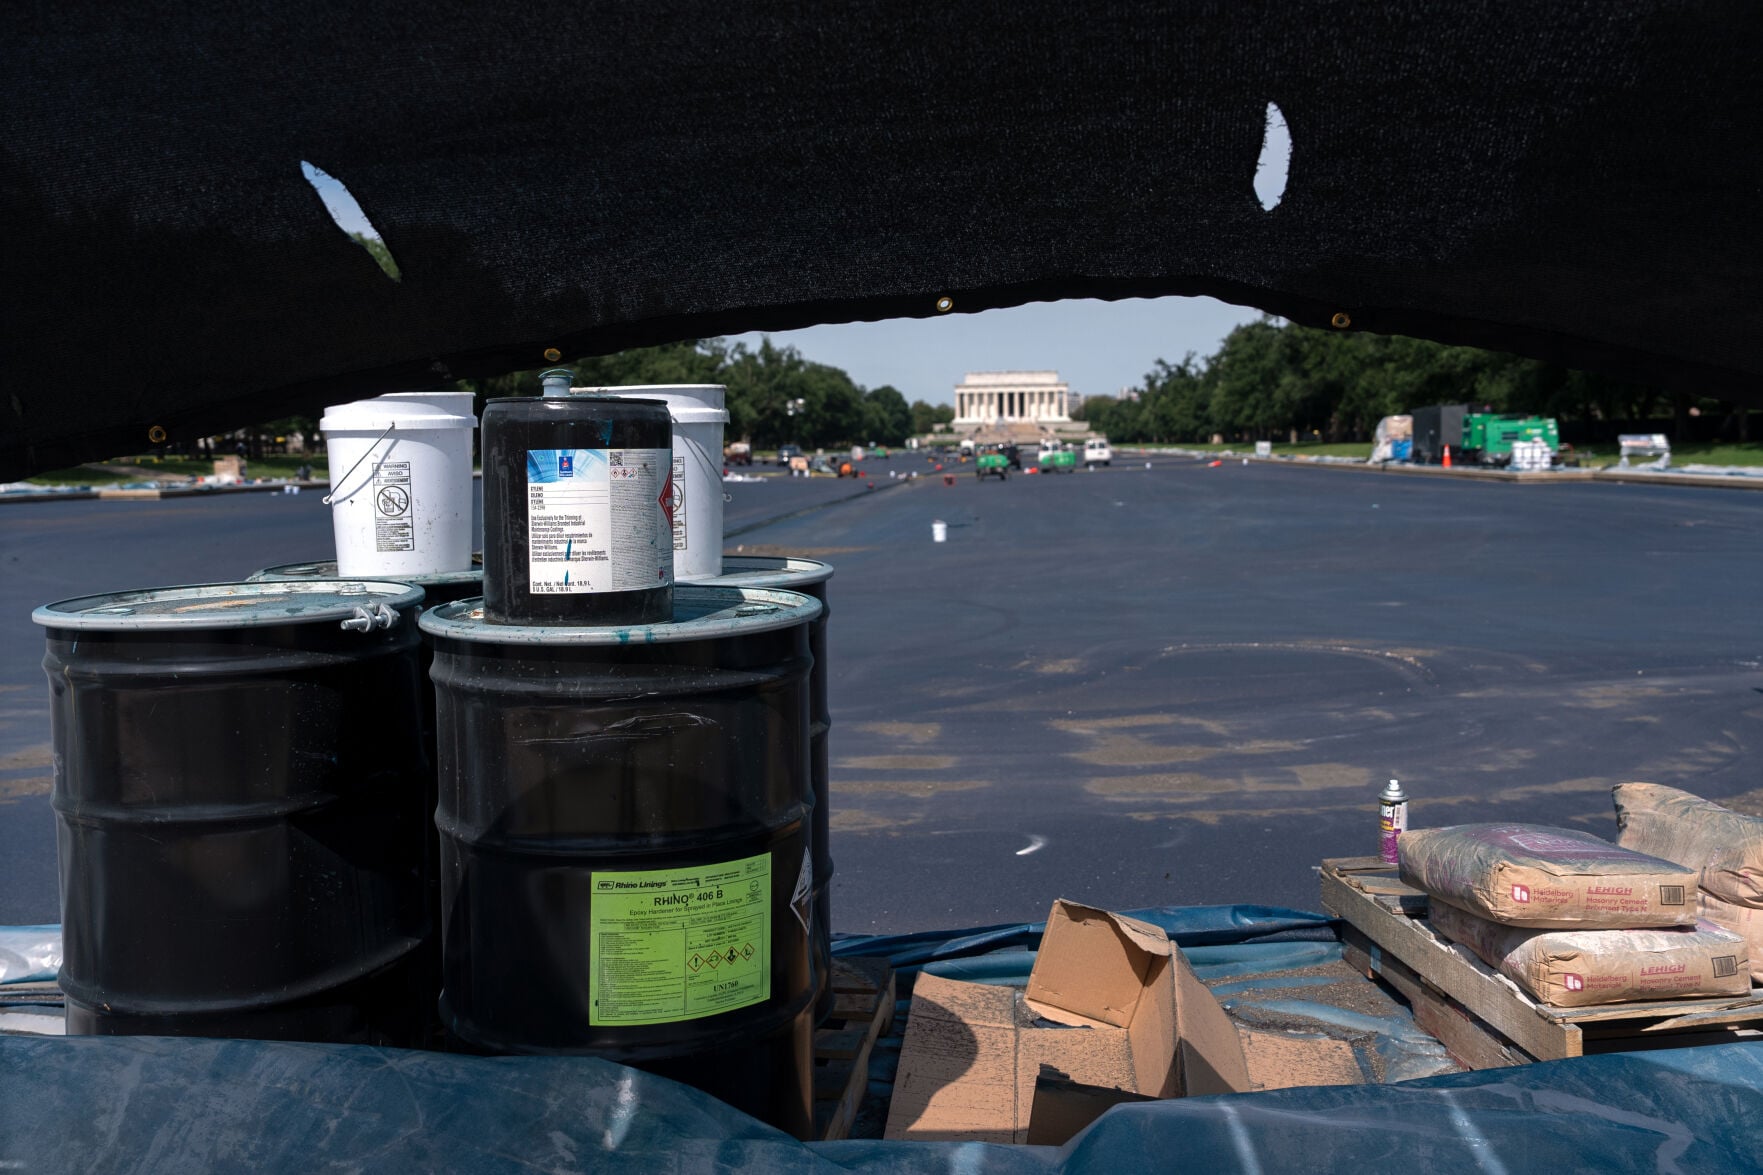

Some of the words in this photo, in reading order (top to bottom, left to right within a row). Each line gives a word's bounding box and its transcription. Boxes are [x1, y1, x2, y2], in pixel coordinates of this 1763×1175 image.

[1533, 888, 1573, 897] Heidelberg
[1587, 886, 1632, 894] LEHIGH
[697, 891, 713, 901] 406
[717, 890, 723, 898] B
[1640, 964, 1686, 975] LEHIGH
[1587, 975, 1627, 983] Heidelberg
